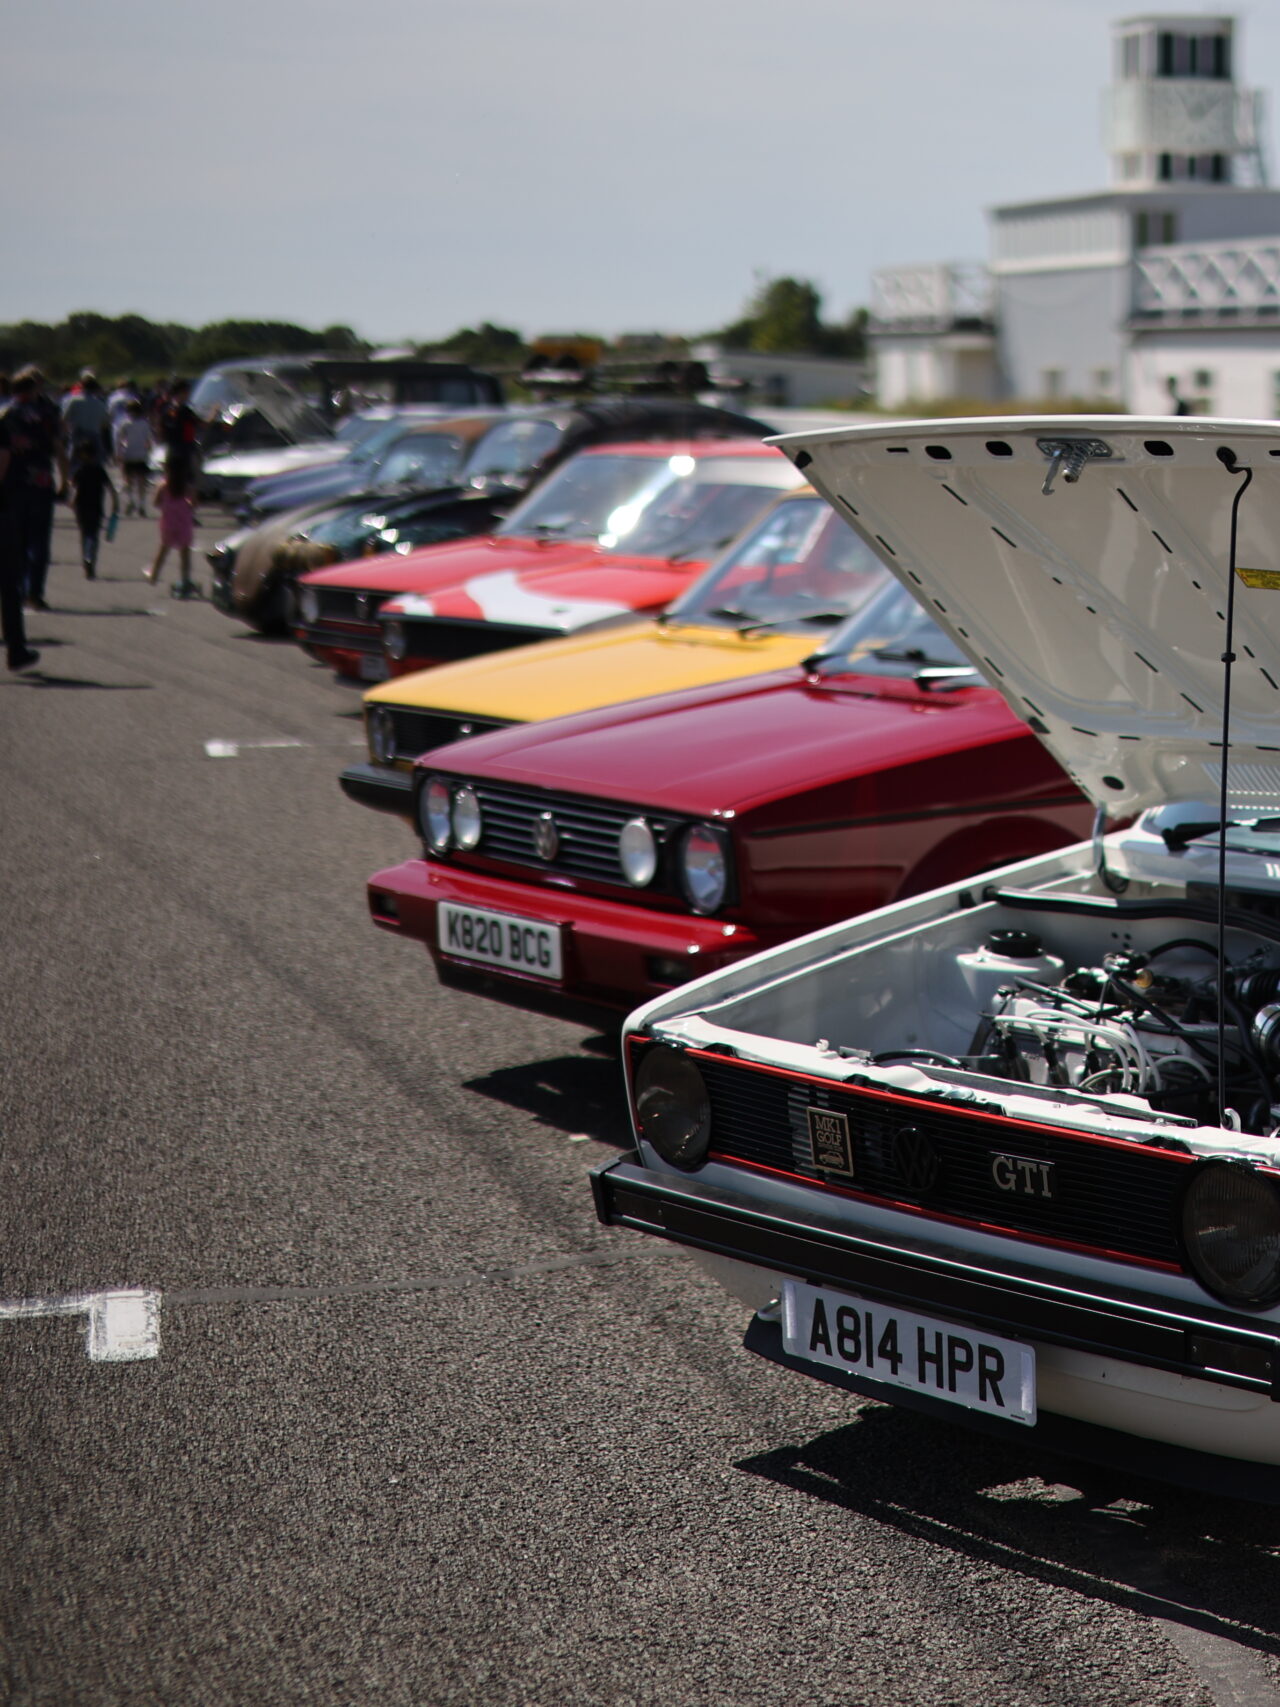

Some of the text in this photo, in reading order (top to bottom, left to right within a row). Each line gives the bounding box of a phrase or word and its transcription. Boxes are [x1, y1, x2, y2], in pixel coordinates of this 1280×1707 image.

[447, 911, 551, 969] K820 BCG
[814, 1115, 842, 1136] MK1
[816, 1130, 843, 1147] GOLF
[993, 1156, 1052, 1198] GTI
[809, 1298, 1005, 1407] A814 HPR
